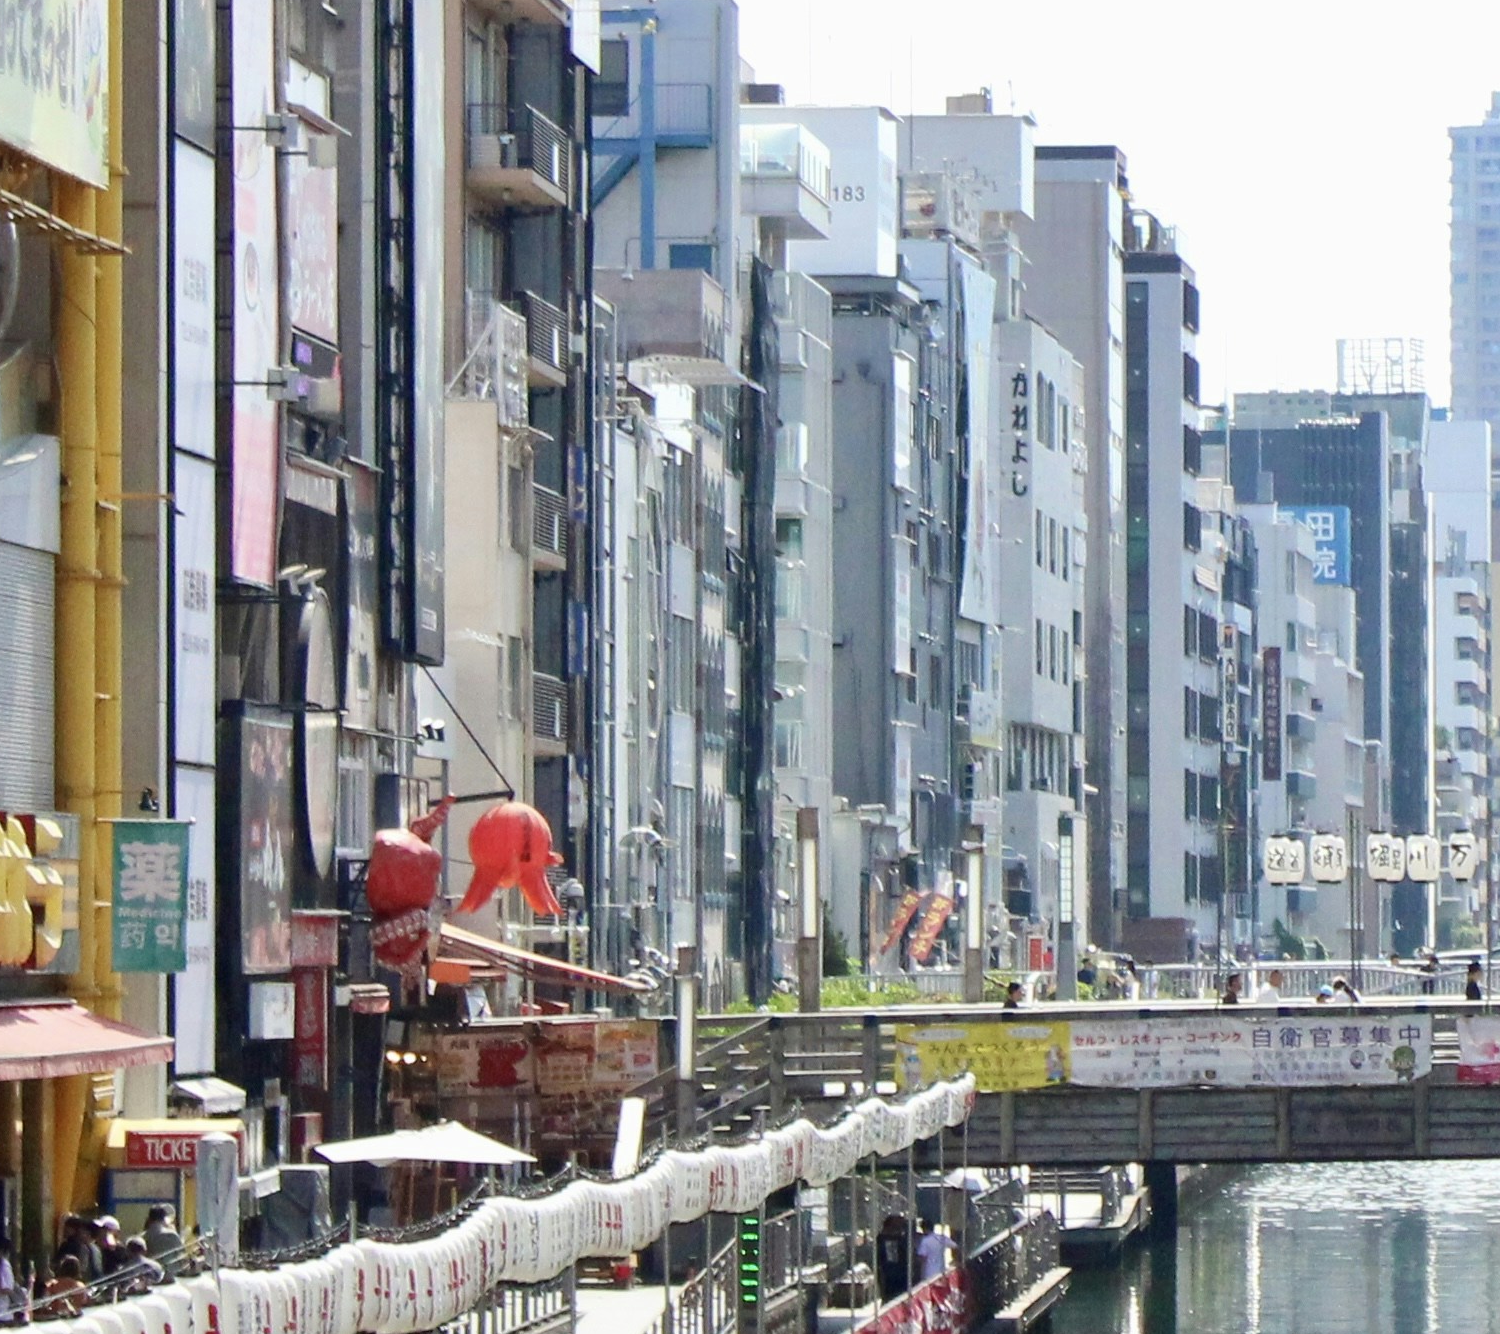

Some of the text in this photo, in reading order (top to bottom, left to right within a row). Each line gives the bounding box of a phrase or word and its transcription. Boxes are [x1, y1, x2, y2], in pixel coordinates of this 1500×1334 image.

[119, 841, 181, 902] 薬
[118, 907, 182, 920] Medicine
[1252, 1025, 1420, 1048] 自衛官募集中
